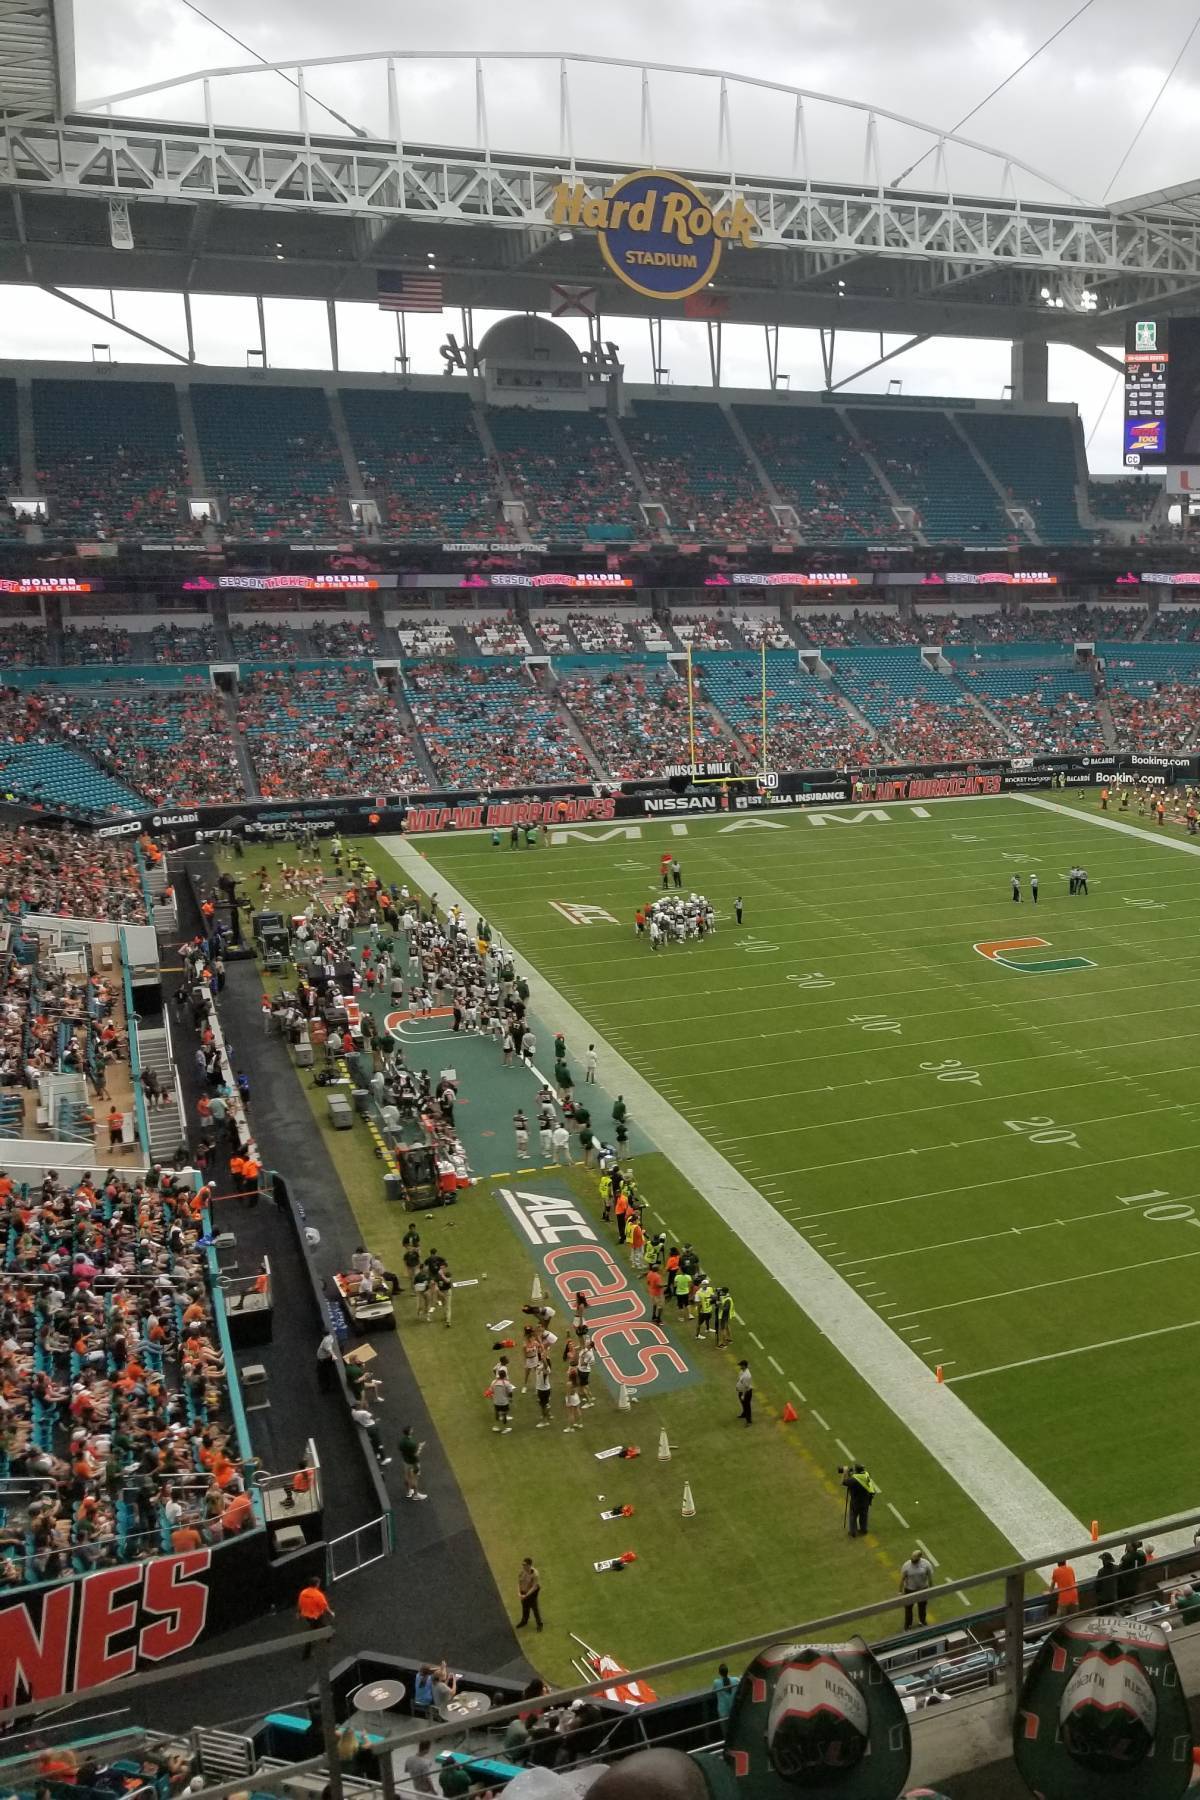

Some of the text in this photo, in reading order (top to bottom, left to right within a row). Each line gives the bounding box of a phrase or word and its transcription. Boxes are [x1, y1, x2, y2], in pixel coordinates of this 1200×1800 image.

[552, 182, 759, 248] Hard Rock
[625, 250, 698, 269] STADIUM
[1127, 456, 1138, 464] CC
[442, 544, 548, 552] NATIONAL CHAMPIONS
[220, 576, 264, 589] SEASON
[707, 763, 731, 775] MILK
[1131, 755, 1190, 767] Booking.com
[1096, 772, 1165, 785] Bookin.com
[644, 796, 717, 811] NISSAN
[161, 812, 199, 826] BACARDÍ
[407, 806, 484, 833] MIAMI
[551, 807, 932, 846] MIAMI
[98, 821, 142, 838] GEICO
[734, 935, 779, 953] 40
[786, 972, 835, 988] 50
[847, 1014, 901, 1031] 40
[919, 1059, 980, 1082] 30
[1003, 1116, 1076, 1144] 20
[1116, 1189, 1194, 1221] 10
[500, 1188, 598, 1245] ACC
